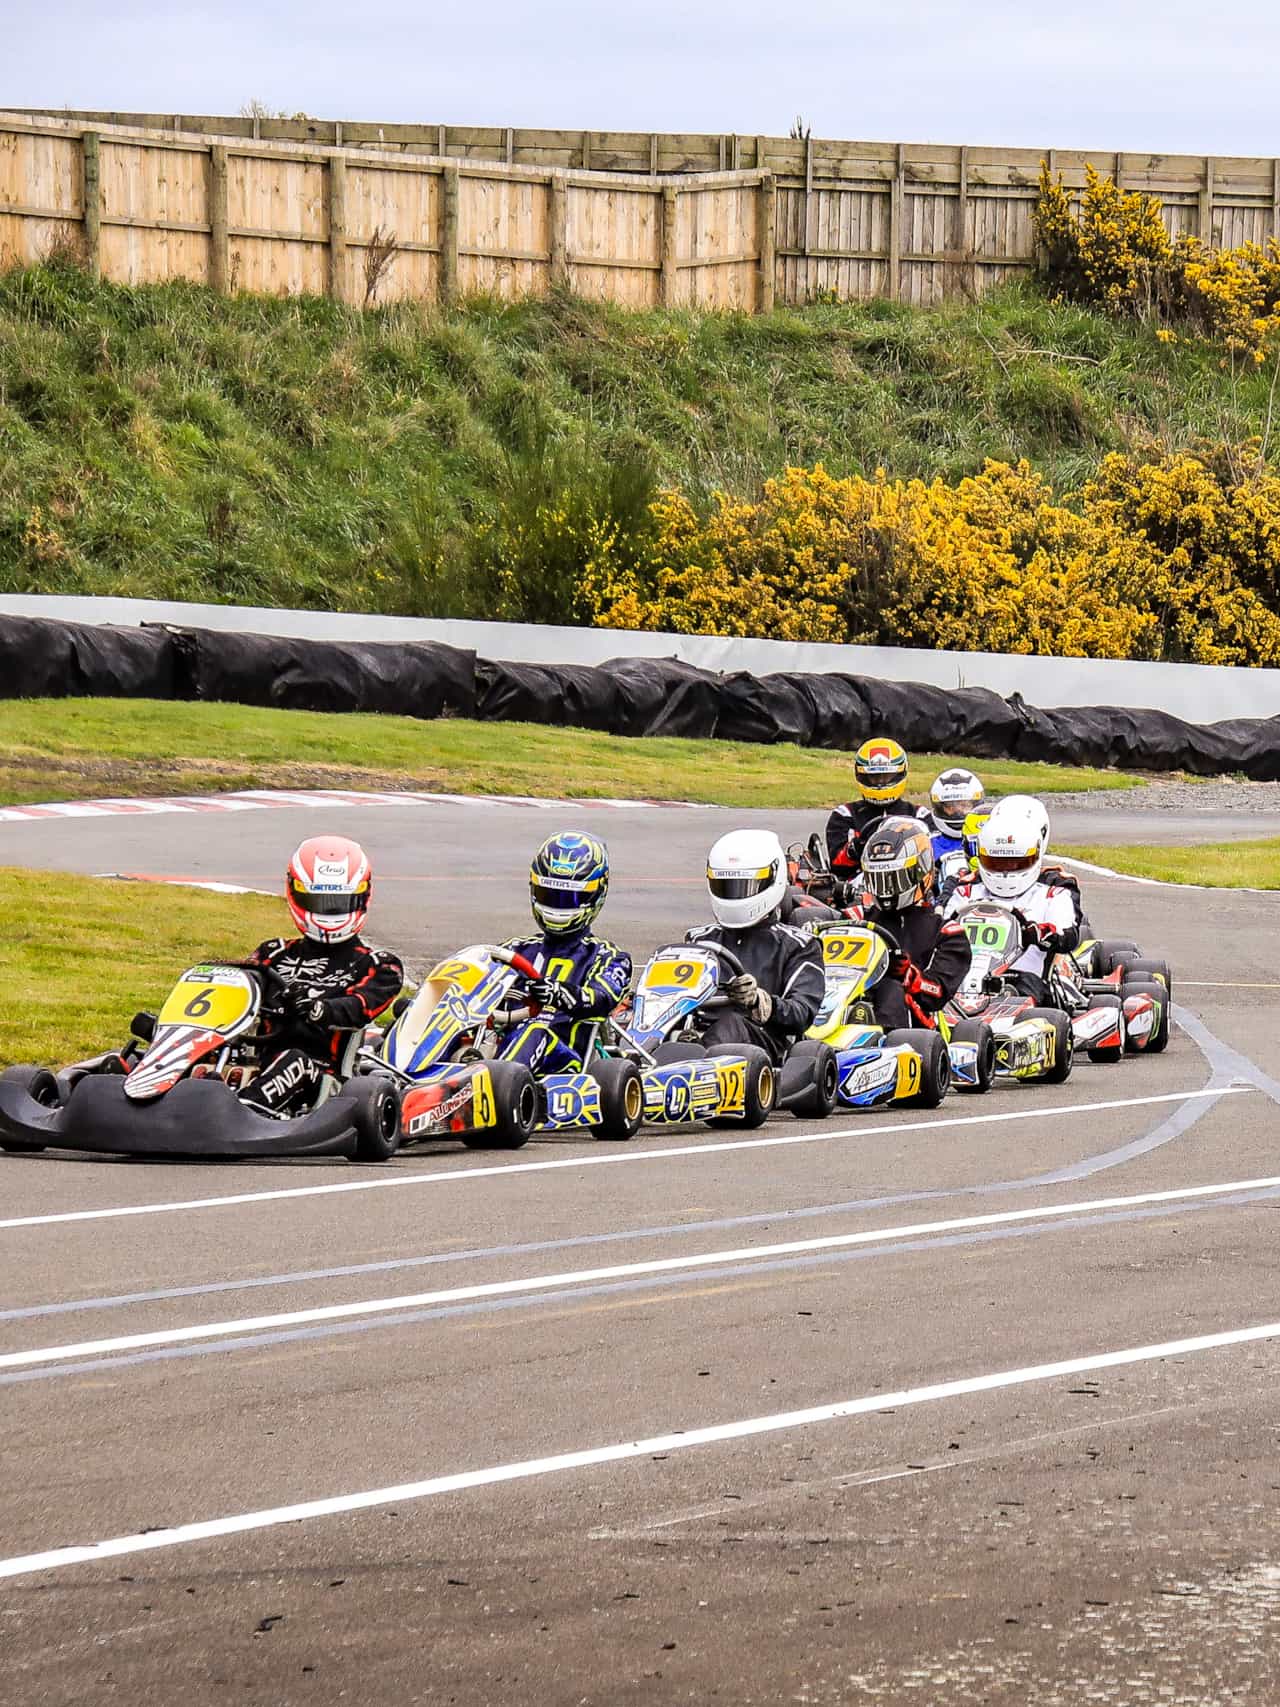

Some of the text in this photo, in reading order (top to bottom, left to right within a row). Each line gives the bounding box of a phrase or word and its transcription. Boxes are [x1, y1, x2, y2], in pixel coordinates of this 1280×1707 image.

[967, 925, 999, 945] 10
[826, 940, 865, 961] 97
[433, 962, 470, 981] 12
[674, 964, 694, 984] 9
[184, 988, 215, 1018] 6
[908, 1057, 917, 1092] 9
[480, 1074, 490, 1123] 6
[720, 1070, 739, 1108] 12
